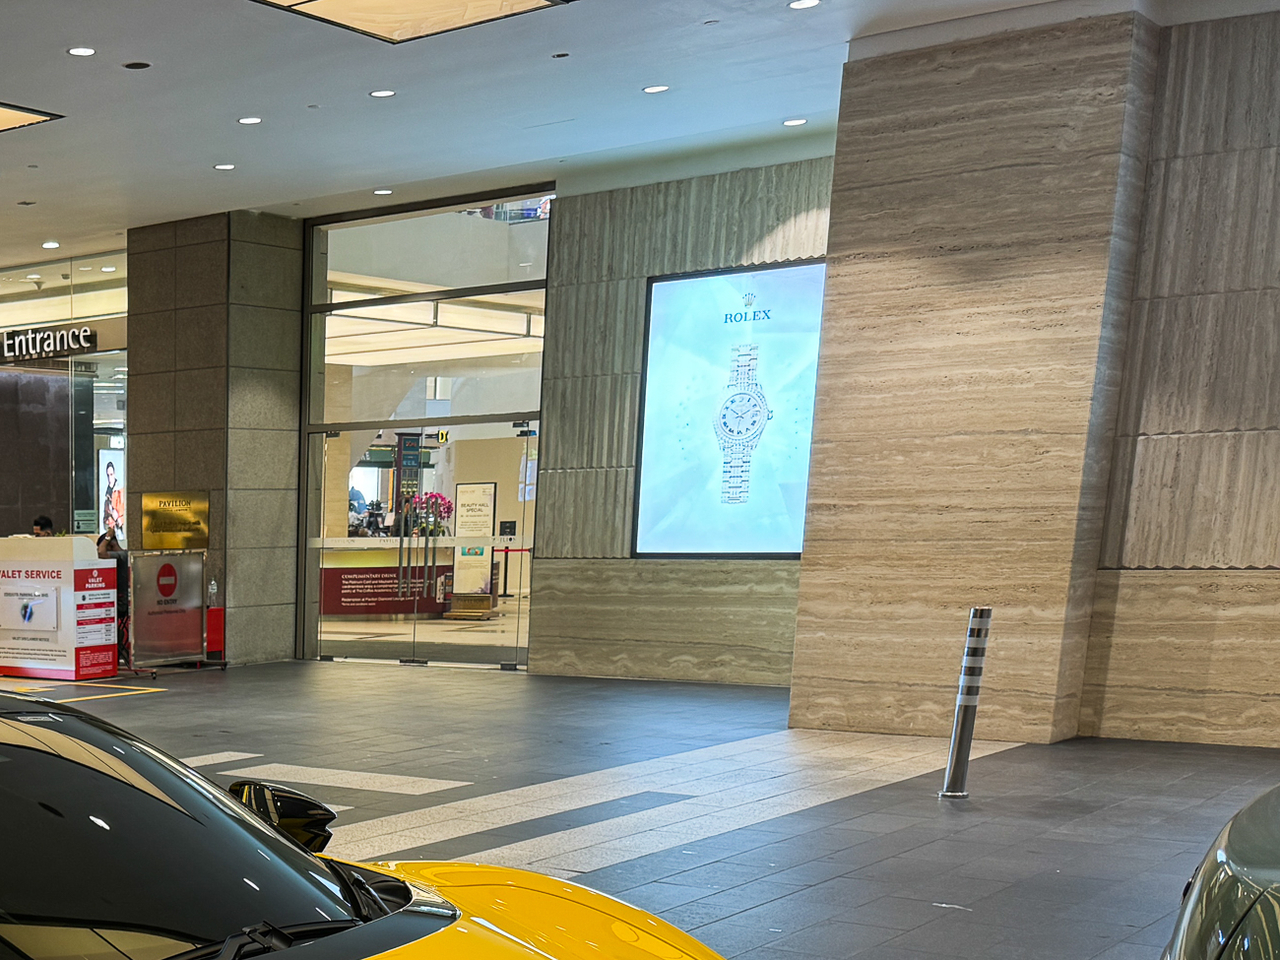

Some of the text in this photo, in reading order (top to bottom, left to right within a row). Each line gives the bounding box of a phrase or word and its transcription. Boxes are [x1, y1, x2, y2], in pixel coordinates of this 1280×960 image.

[723, 309, 771, 323] ROLEX
[3, 326, 91, 357] Entrance
[24, 570, 62, 579] SERVICE
